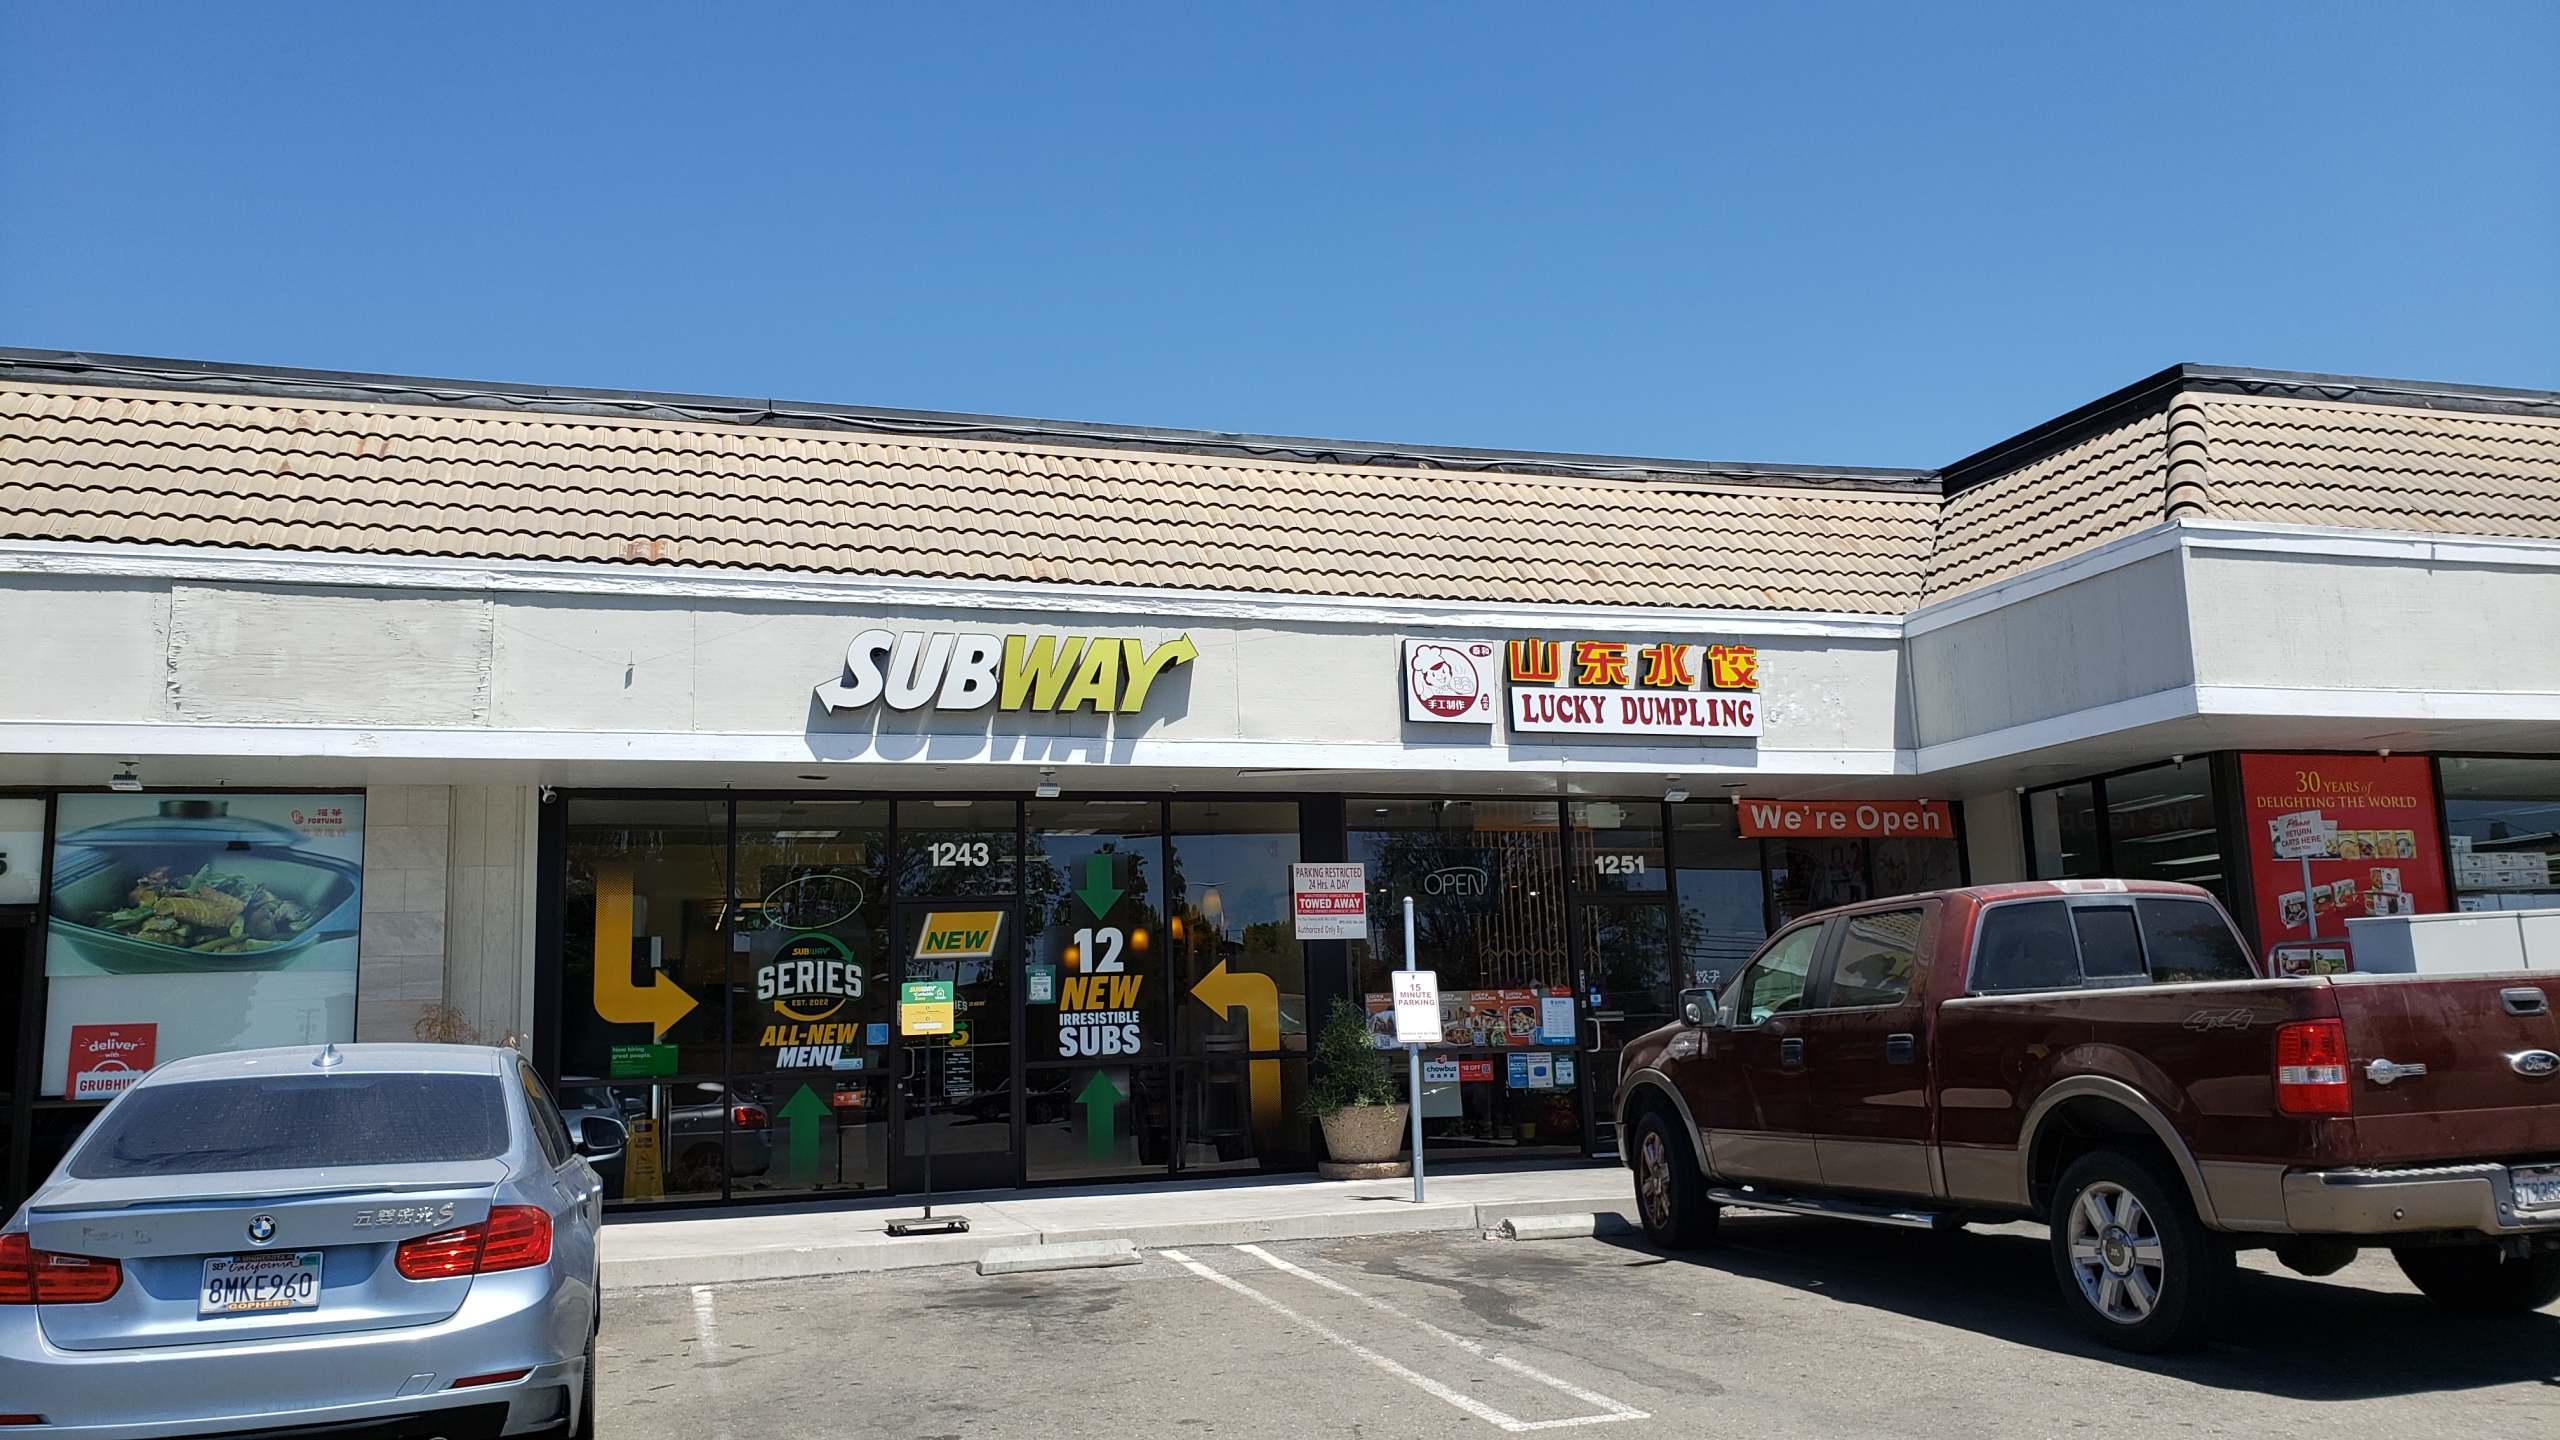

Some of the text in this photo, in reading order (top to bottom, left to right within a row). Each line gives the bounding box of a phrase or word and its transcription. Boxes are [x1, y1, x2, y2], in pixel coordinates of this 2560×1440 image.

[1509, 638, 1758, 689] 山东水饺
[814, 628, 1199, 716] SUBWAY
[1428, 700, 1465, 710] 手工制作
[1521, 694, 1754, 727] LUCKY DUMPLING
[2296, 771, 2373, 796] 30 YEARS of
[2257, 796, 2417, 808] DELIGHTING THE WORLD
[1856, 805, 1940, 836] Open
[2286, 818, 2310, 829] Please
[2286, 828, 2312, 838] RETURN
[2282, 835, 2322, 847] CARTS HERE
[928, 843, 989, 867] 1243
[1595, 855, 1645, 874] 1251
[1296, 867, 1362, 878] PARKING RESTRICTED
[1308, 879, 1350, 890] 24 Hrs. A DAY
[1425, 873, 1484, 896] OPEN
[1299, 898, 1361, 909] TOWED AWAY
[1298, 925, 1324, 934] Authorized
[1325, 925, 1336, 935] Only
[926, 930, 989, 951] NEW
[792, 948, 830, 956] SUBWAY
[1073, 927, 1124, 973] 12
[757, 961, 862, 1000] SERIES
[1695, 969, 1720, 984] 饺子
[909, 985, 936, 993] SUBWAY
[1060, 975, 1144, 1011] NEW
[1059, 1011, 1140, 1026] IRRESISTIBLE
[2183, 1008, 2254, 1031] 4x4
[759, 1023, 859, 1047] ALL-NEW
[1059, 1024, 1141, 1057] SUBS
[89, 1039, 138, 1052] deliver
[776, 1045, 842, 1068] MENU
[2526, 1056, 2553, 1071] Ford
[243, 1254, 285, 1262] MINNESOTA
[212, 1263, 226, 1271] SEP
[229, 1260, 300, 1274] California
[209, 1272, 313, 1304] 8MKE960
[229, 1300, 290, 1309] GOPHERS
